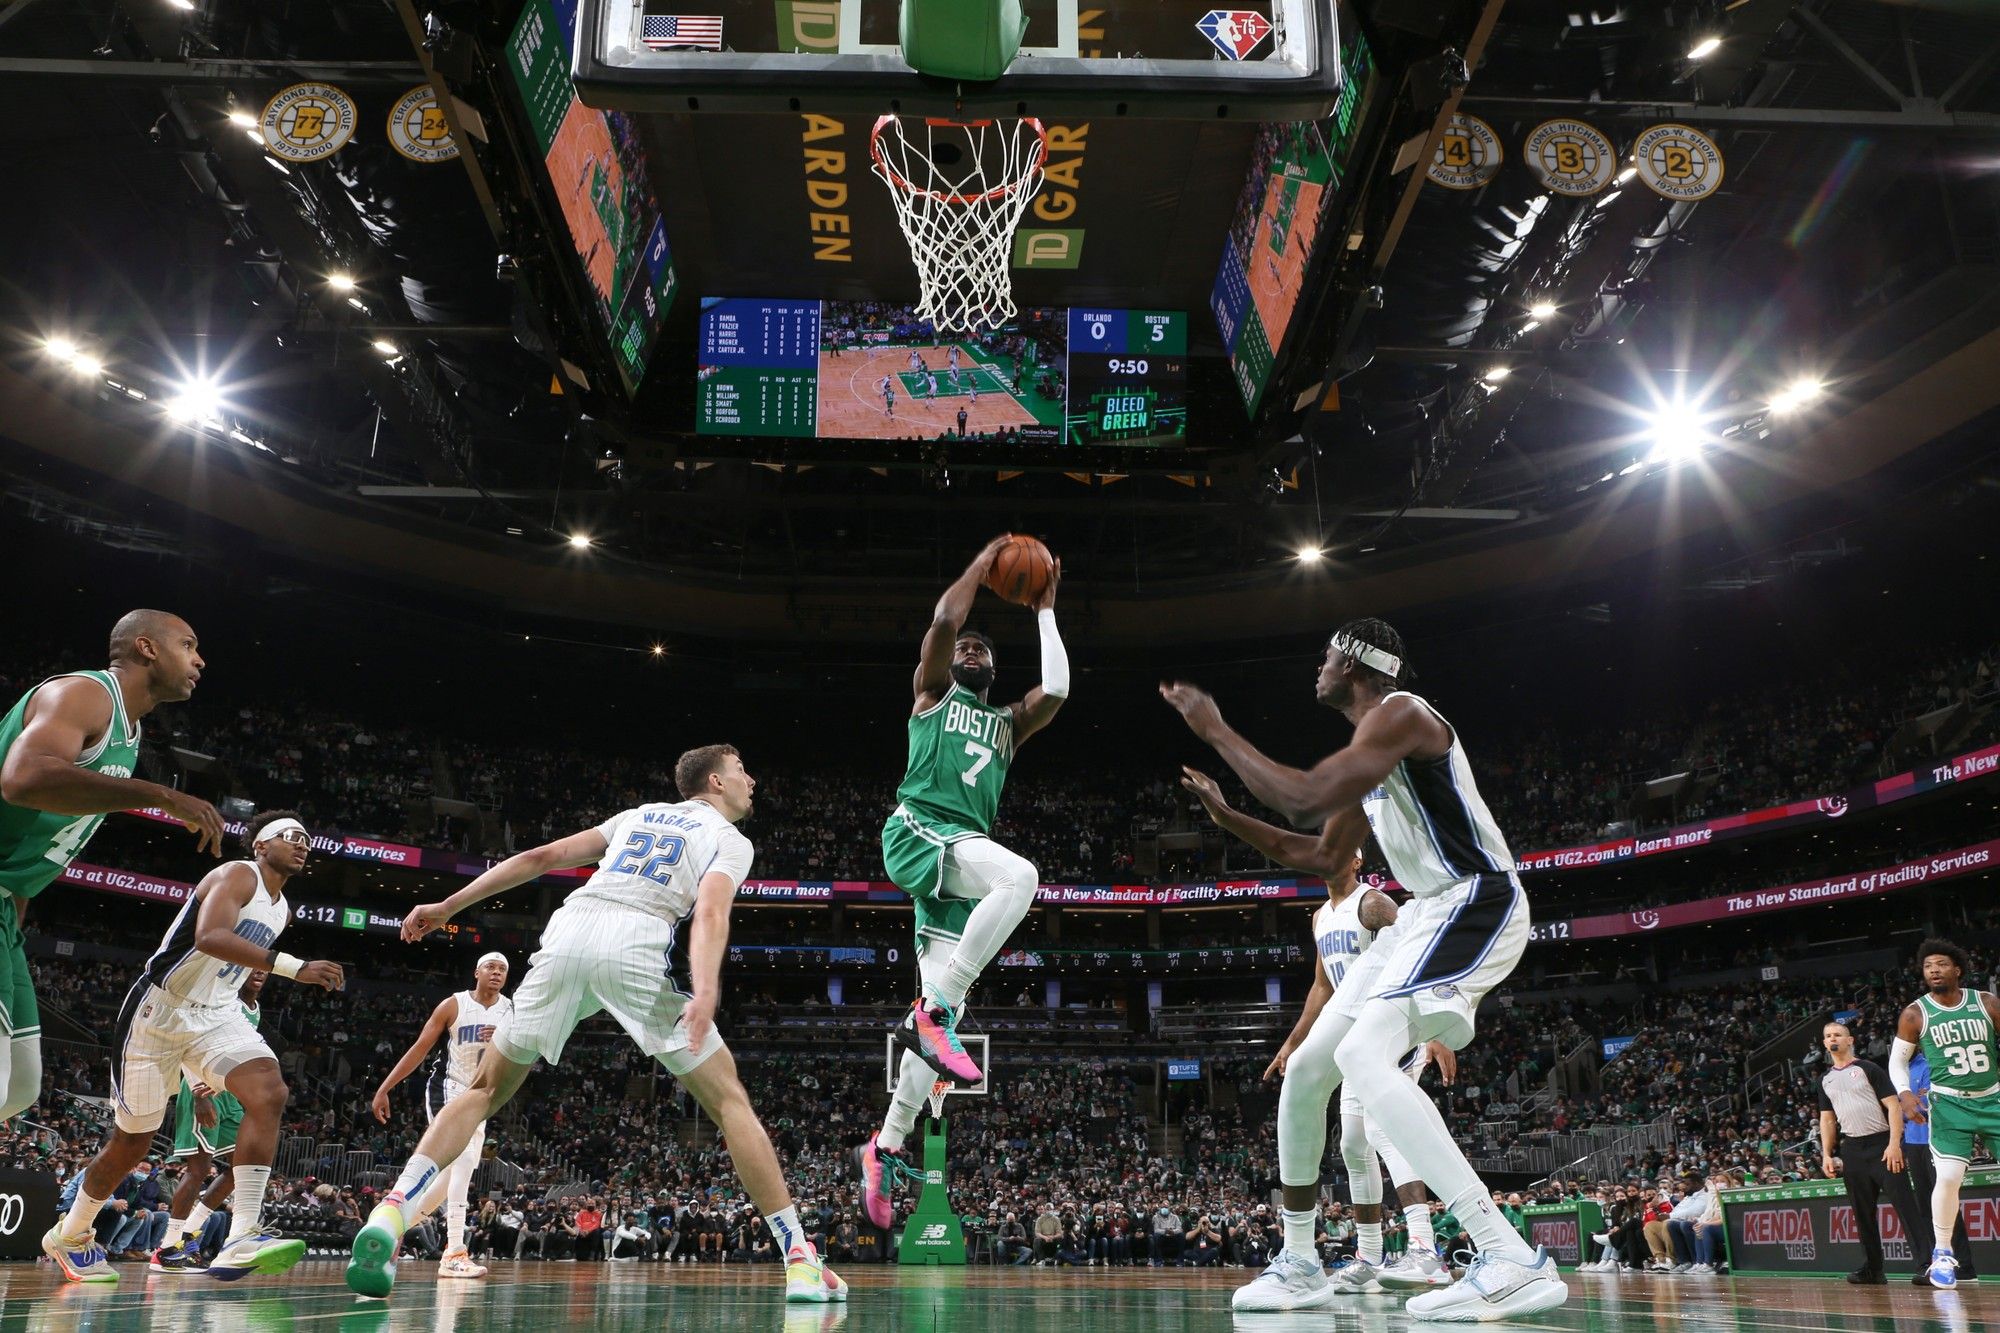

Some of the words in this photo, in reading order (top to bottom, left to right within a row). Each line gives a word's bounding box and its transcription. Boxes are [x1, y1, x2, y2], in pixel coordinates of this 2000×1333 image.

[1241, 19, 1255, 35] 75
[265, 88, 305, 127] RAYMOND
[322, 88, 350, 131] BOURQUE
[393, 89, 430, 126] TERENCE
[297, 115, 322, 129] 77
[423, 118, 447, 131] 24
[1474, 124, 1494, 144] ORR
[1529, 128, 1557, 153] LIONEL
[1558, 122, 1609, 157] HITCHMAN
[274, 140, 333, 157] 1979-2000
[1448, 141, 1466, 161] 4
[1639, 128, 1672, 159] EDWARD
[1688, 133, 1718, 165] SHORE
[1561, 148, 1579, 168] 3
[1670, 152, 1688, 173] 2
[801, 113, 852, 263] ARDEN
[1548, 176, 1598, 192] 1925-1934
[1655, 179, 1707, 195] 1926-1940
[1083, 313, 1112, 322] ORLANDO
[1145, 315, 1170, 324] BOSTON
[1091, 322, 1106, 340] 0
[1151, 325, 1164, 342] 5
[1108, 359, 1149, 374] 9:50
[716, 392, 740, 400] WILLIAMS
[1106, 396, 1145, 413] BLEED
[1102, 412, 1147, 431] GREEN
[944, 700, 1014, 764] BOSTON
[961, 740, 993, 788] 7
[1932, 765, 1962, 783] The
[1964, 753, 2000, 775] New
[643, 812, 703, 832] WAGNER
[44, 814, 104, 868] 4
[311, 836, 343, 854] ility
[345, 842, 406, 861] Services
[1516, 860, 1532, 871] us
[1535, 857, 1551, 869] at
[1554, 848, 1615, 867] UG2.com
[1618, 844, 1632, 857] to
[1635, 837, 1671, 854] learn
[1675, 828, 1712, 846] more
[606, 831, 687, 886] 22
[65, 867, 84, 879] us
[86, 871, 103, 882] at
[106, 872, 167, 895] UG2.com
[169, 885, 183, 898] to
[740, 884, 754, 895] to
[757, 883, 792, 895] learn
[796, 886, 830, 896] more
[1727, 896, 1753, 912] The
[1756, 892, 1786, 907] New
[1789, 877, 1857, 902] Standard
[1860, 874, 1877, 893] of
[1879, 864, 1928, 887] Facility
[1931, 849, 1989, 875] Services
[1037, 888, 1059, 900] The
[1062, 888, 1091, 900] New
[1093, 888, 1154, 901] Standard
[1157, 888, 1170, 903] of
[1173, 886, 1221, 901] Facility
[1224, 885, 1280, 897] Services
[296, 904, 336, 923] 6:12
[370, 915, 403, 928] Bank
[1528, 922, 1569, 941] 6:12
[1318, 930, 1361, 959] MAGIC
[887, 949, 899, 963] 0
[1929, 1018, 1989, 1048] BOSTON
[1943, 1043, 1990, 1076] 36
[926, 1170, 943, 1178] VISTA
[1532, 1221, 1578, 1249] KENDA
[1743, 1208, 1814, 1245] KENDA
[1785, 1243, 1816, 1260] TIRES
[1882, 1241, 1914, 1260] TIRE
